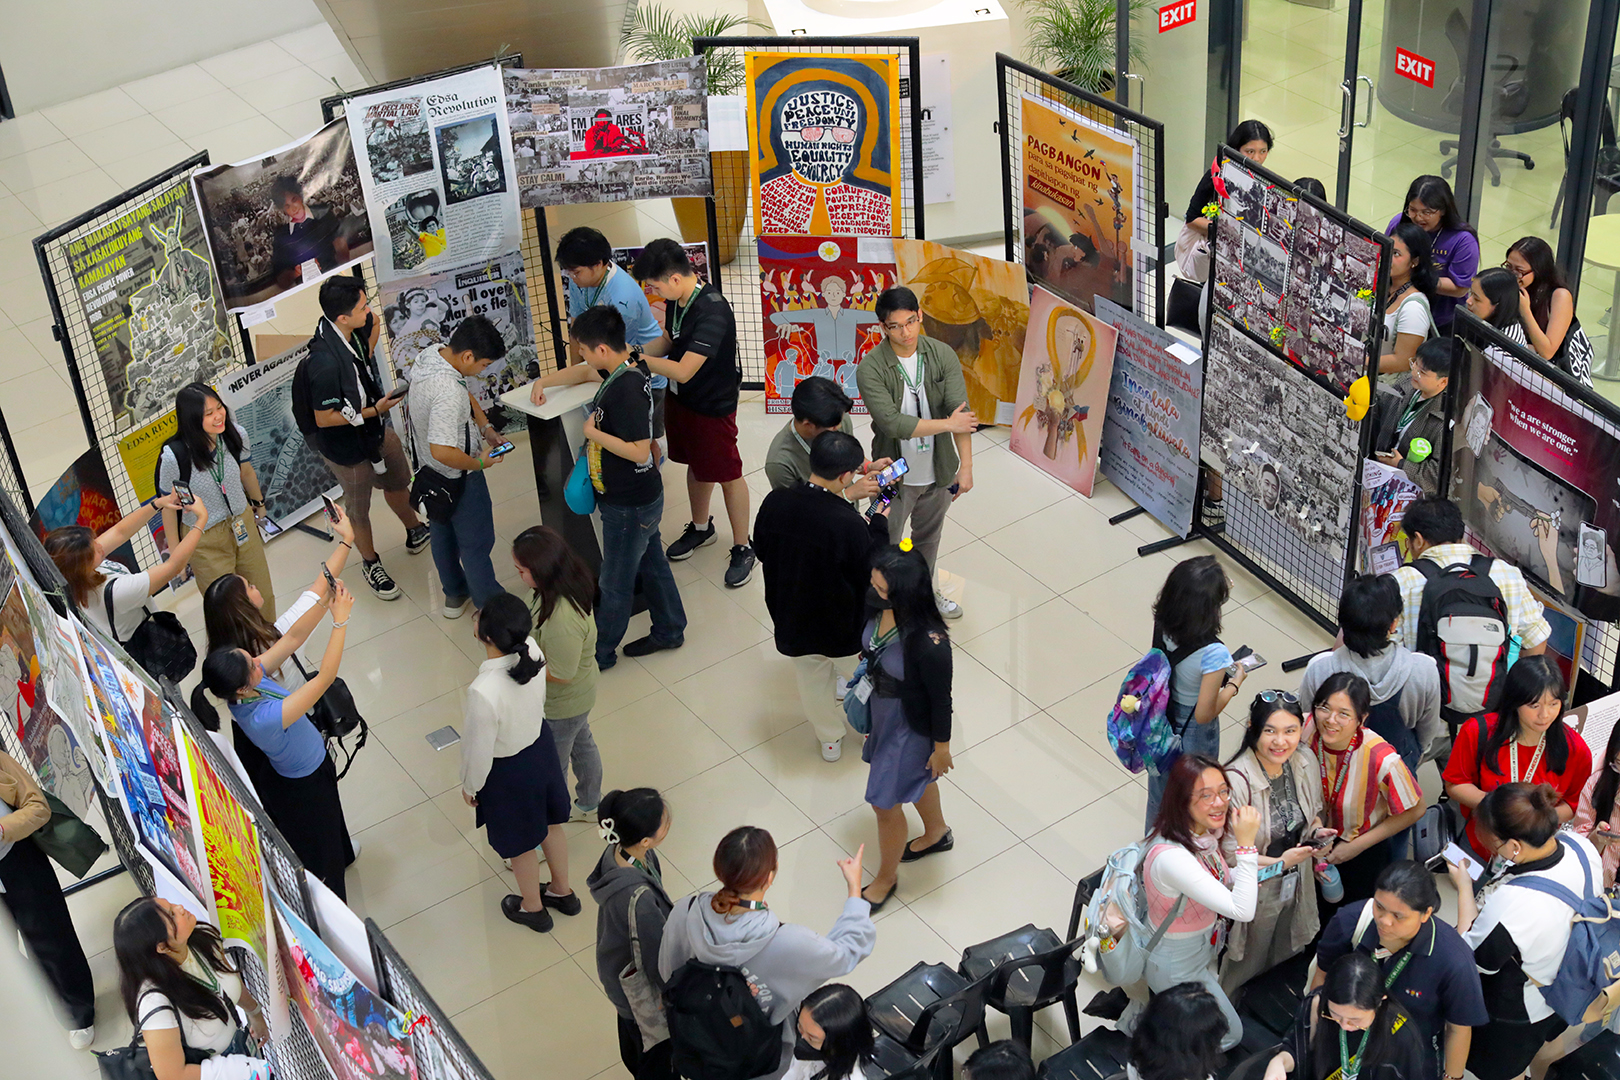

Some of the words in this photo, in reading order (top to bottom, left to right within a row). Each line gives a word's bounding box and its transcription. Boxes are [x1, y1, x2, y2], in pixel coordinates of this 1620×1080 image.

[1161, 2, 1194, 27] EXIT
[1397, 53, 1432, 81] EXIT
[382, 102, 420, 111] DECLARES
[426, 93, 459, 107] Edsa
[428, 96, 497, 118] Revolution
[787, 92, 854, 111] JUSTICE
[366, 109, 399, 118] MARTIAL
[401, 109, 420, 117] LAW
[571, 117, 586, 129] FM
[785, 140, 820, 150] HUMAN
[821, 142, 852, 151] RIGHTS
[791, 150, 851, 165] EQUALITY
[1028, 134, 1101, 180] PAGBANGON
[520, 176, 539, 185] STAY
[541, 173, 565, 182] CALM!
[1028, 151, 1044, 165] para
[1045, 160, 1053, 170] sa
[1054, 166, 1086, 186] pagsipat
[1088, 182, 1098, 194] ng
[1028, 164, 1068, 192] dapithapon
[1070, 186, 1080, 200] ng
[1031, 179, 1074, 208] kinabukasan
[69, 240, 86, 257] ANG
[84, 203, 152, 248] MAKASAYSAYANG
[150, 182, 188, 212] SALAYSAY
[73, 258, 86, 273] SA
[85, 226, 144, 268] KASALUKUYANG
[78, 254, 127, 290] KAMALAYAN
[82, 287, 98, 302] EDSA
[97, 277, 117, 295] PEOPLE
[115, 267, 135, 285] POWER
[85, 289, 118, 313] REVOLUTION
[263, 354, 294, 375] AGAIN
[1134, 396, 1144, 412] at
[1145, 403, 1170, 428] hindi
[1510, 412, 1528, 430] when
[1530, 425, 1542, 438] we
[1542, 432, 1555, 446] are
[1520, 411, 1526, 419] a
[1526, 414, 1541, 426] are
[1542, 422, 1576, 446] stronger
[82, 491, 108, 508] WAR
[80, 506, 94, 520] ON
[90, 510, 121, 533] DRUGS
